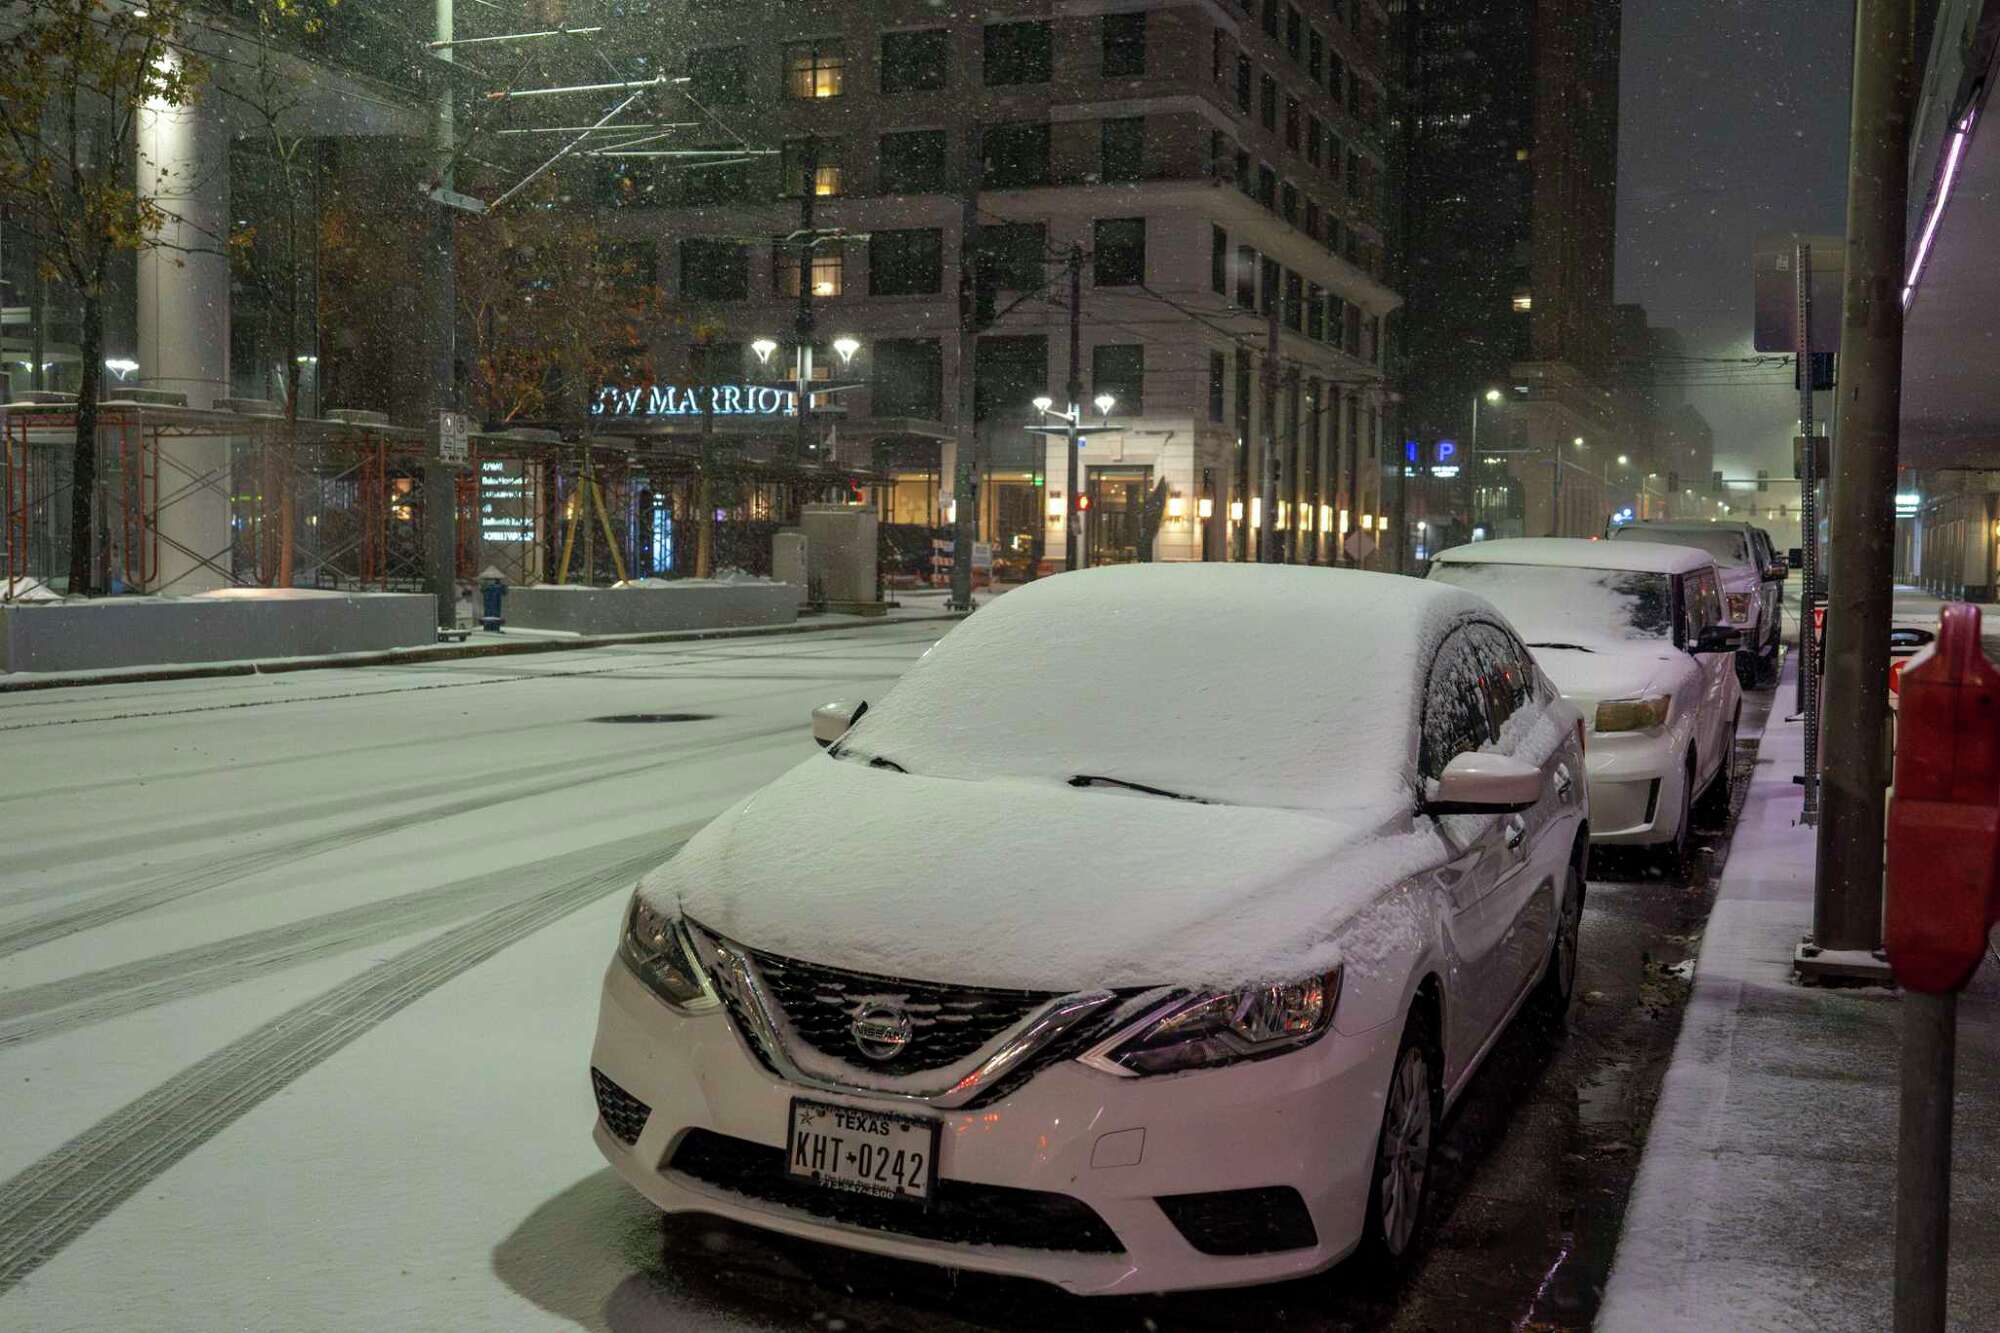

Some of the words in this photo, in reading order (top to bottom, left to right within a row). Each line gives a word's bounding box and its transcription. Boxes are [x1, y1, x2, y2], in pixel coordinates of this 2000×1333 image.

[835, 1113, 890, 1136] TEXAS
[795, 1131, 844, 1172] KHT
[858, 1143, 924, 1189] 0242
